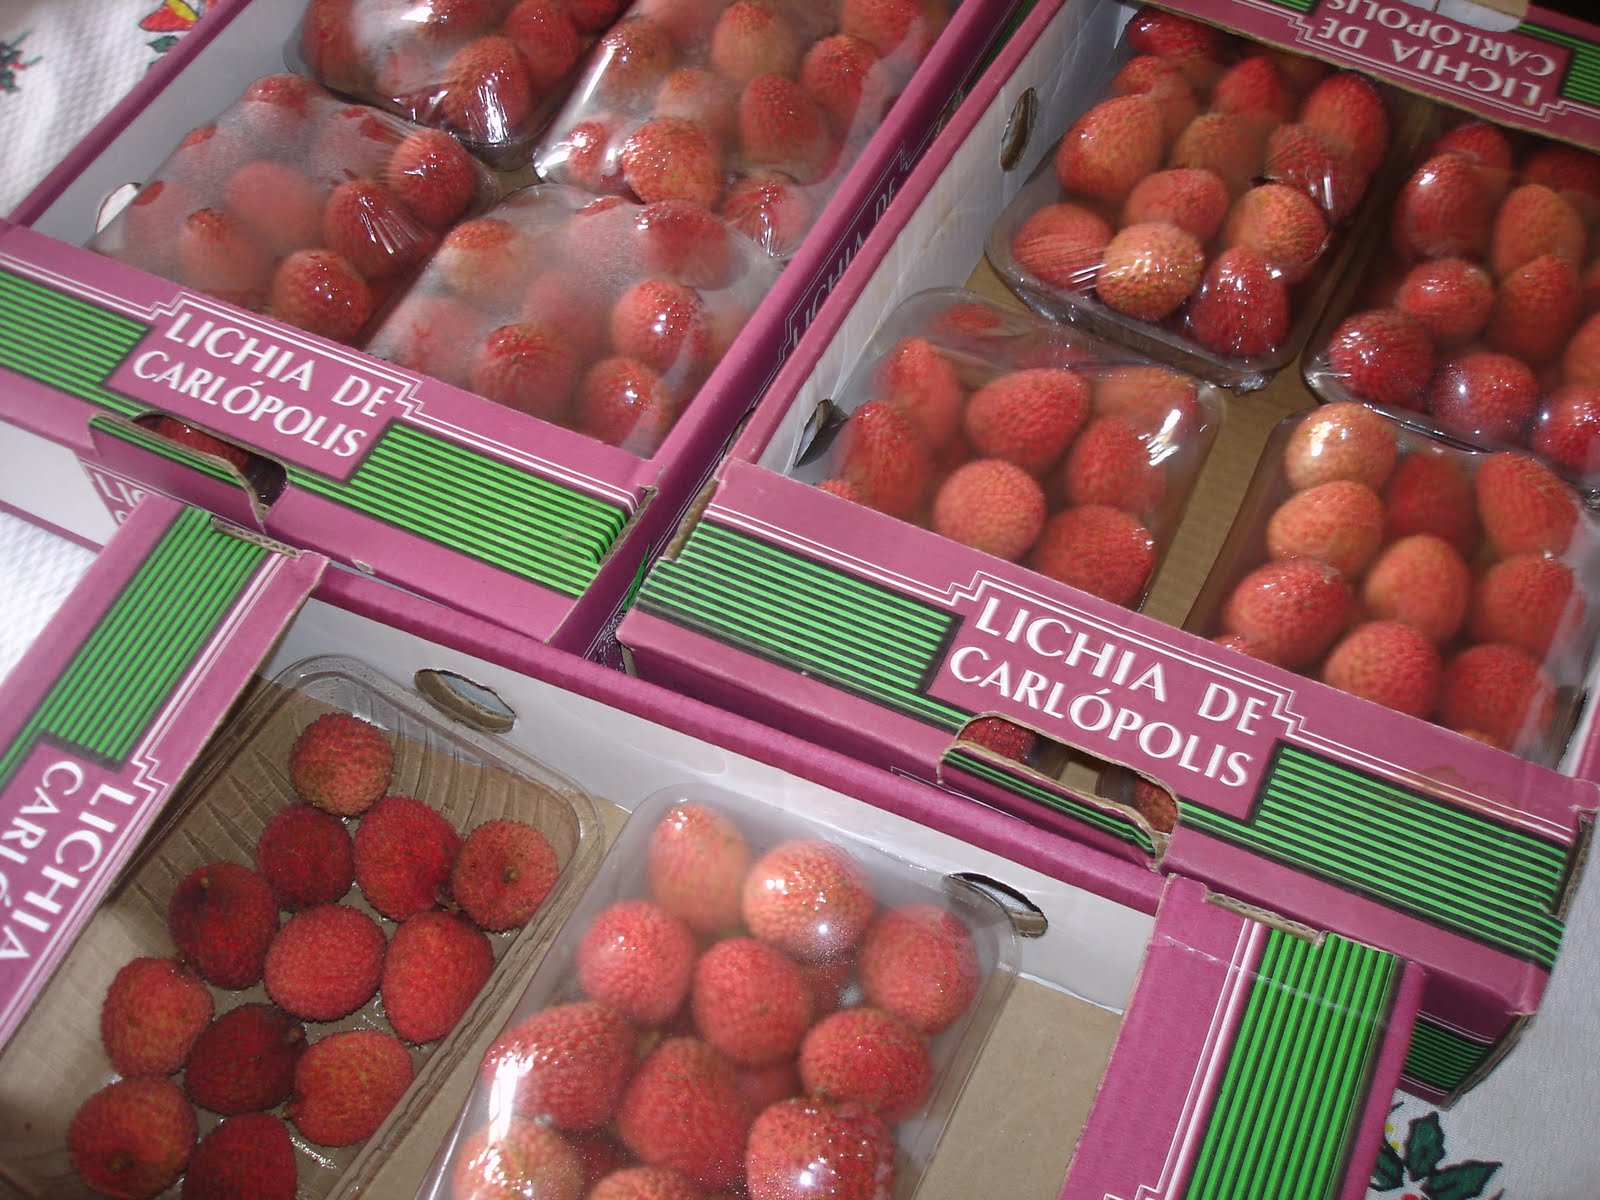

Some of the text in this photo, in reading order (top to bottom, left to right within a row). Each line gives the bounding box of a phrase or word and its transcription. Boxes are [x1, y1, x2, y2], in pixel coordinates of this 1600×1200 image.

[1316, 17, 1541, 107] LICHIA DE
[133, 350, 368, 457] CARLÓPOLIS
[164, 312, 394, 417] LICHIA DE
[949, 645, 1254, 787] CARLÓPOLIS
[975, 597, 1267, 736] LICHIA DE
[0, 783, 137, 958] LICHIA
